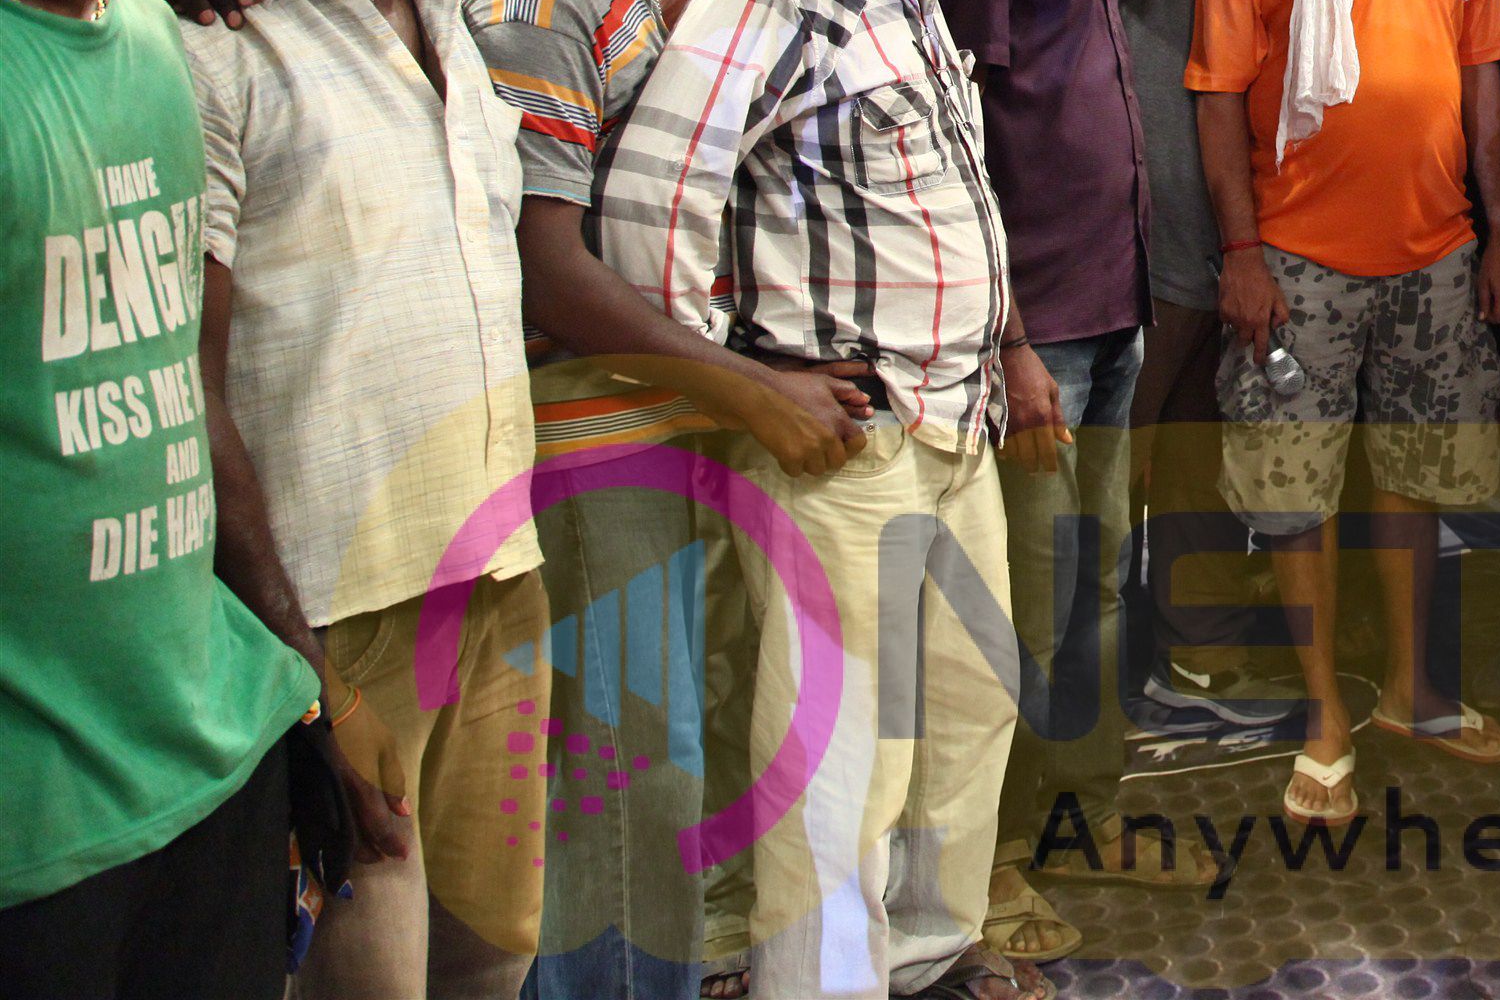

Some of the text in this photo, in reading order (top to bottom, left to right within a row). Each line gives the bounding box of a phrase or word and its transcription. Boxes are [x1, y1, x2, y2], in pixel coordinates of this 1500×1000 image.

[106, 157, 161, 207] HAVE
[55, 375, 152, 456] KISS
[149, 361, 195, 430] ME
[166, 436, 200, 485] AND
[90, 505, 159, 582] DIE
